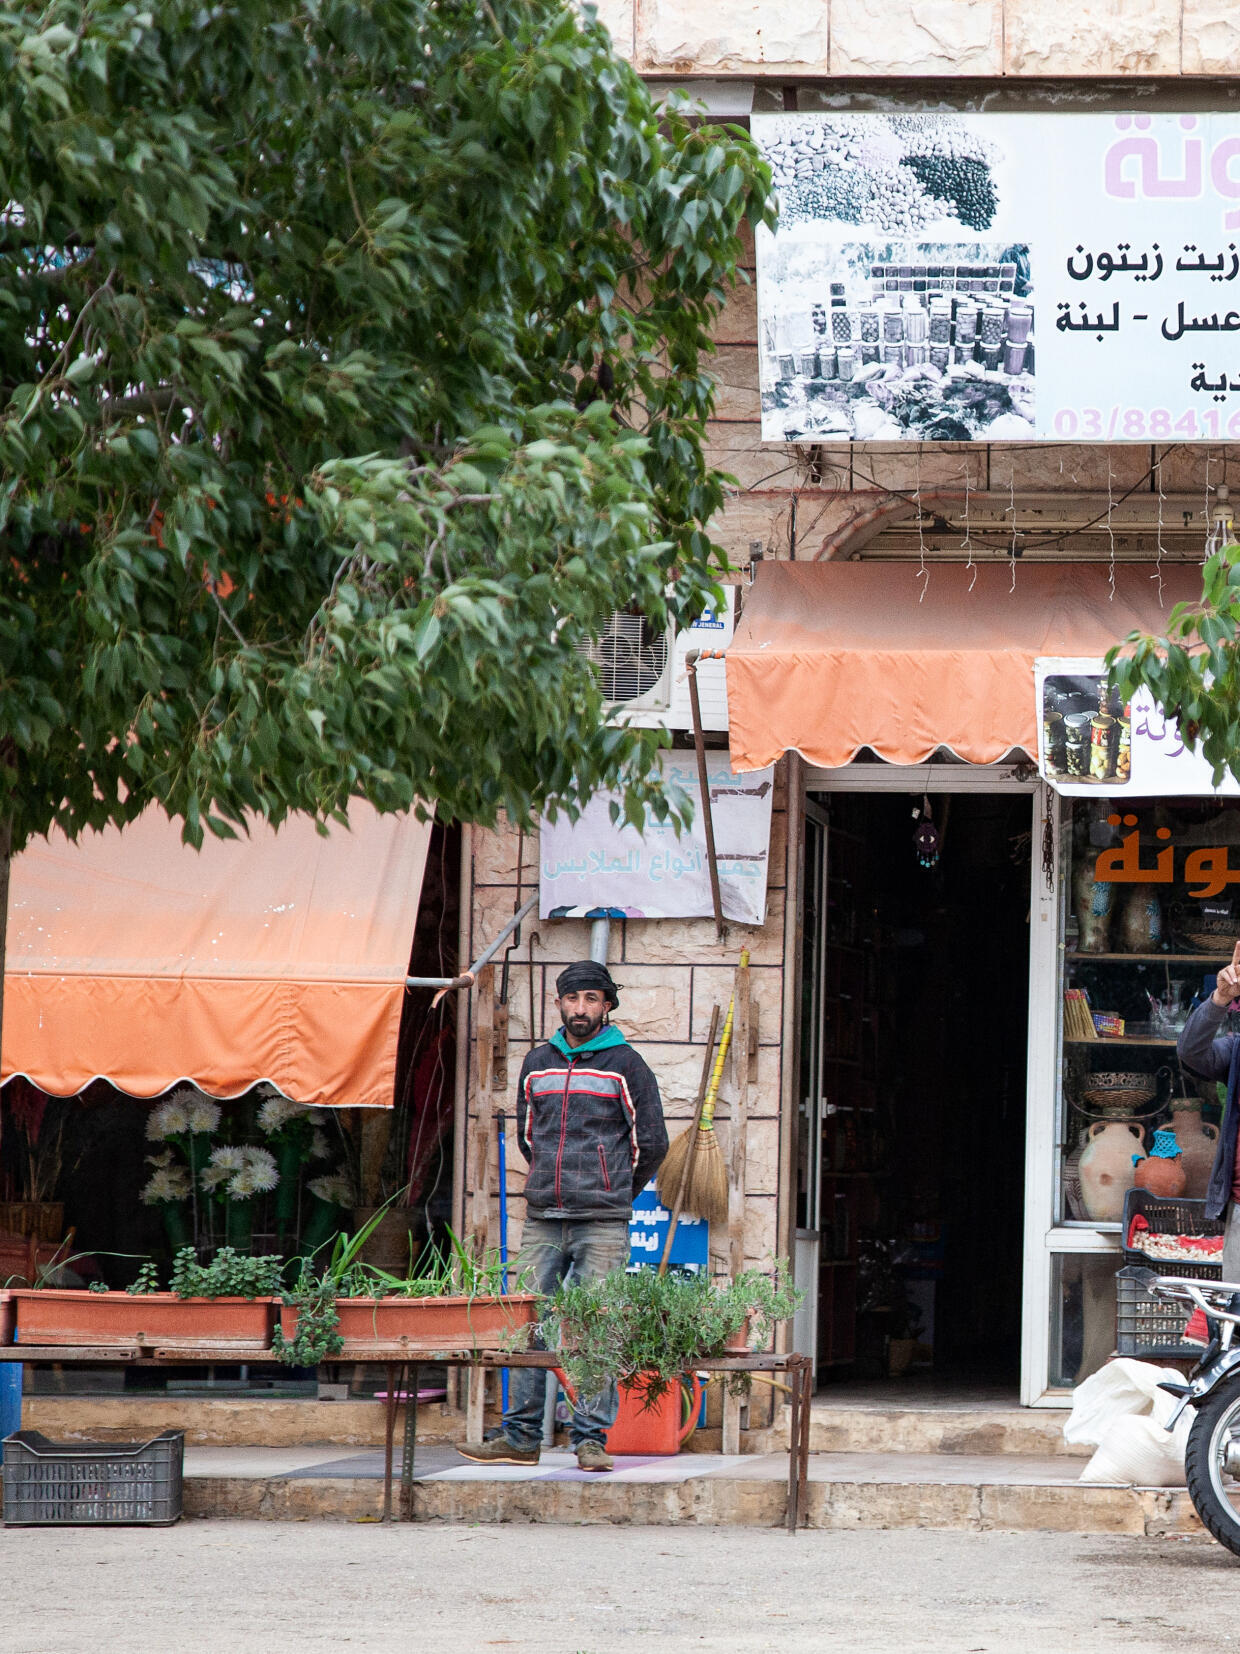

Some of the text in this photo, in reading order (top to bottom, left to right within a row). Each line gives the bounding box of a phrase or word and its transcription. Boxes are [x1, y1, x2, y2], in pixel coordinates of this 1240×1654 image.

[1067, 243, 1164, 282] زيتون
[1176, 243, 1239, 282] زيت
[1056, 301, 1120, 342] لبنة
[1161, 301, 1240, 341] عسل
[543, 844, 762, 884] جمي أنواع الملابس
